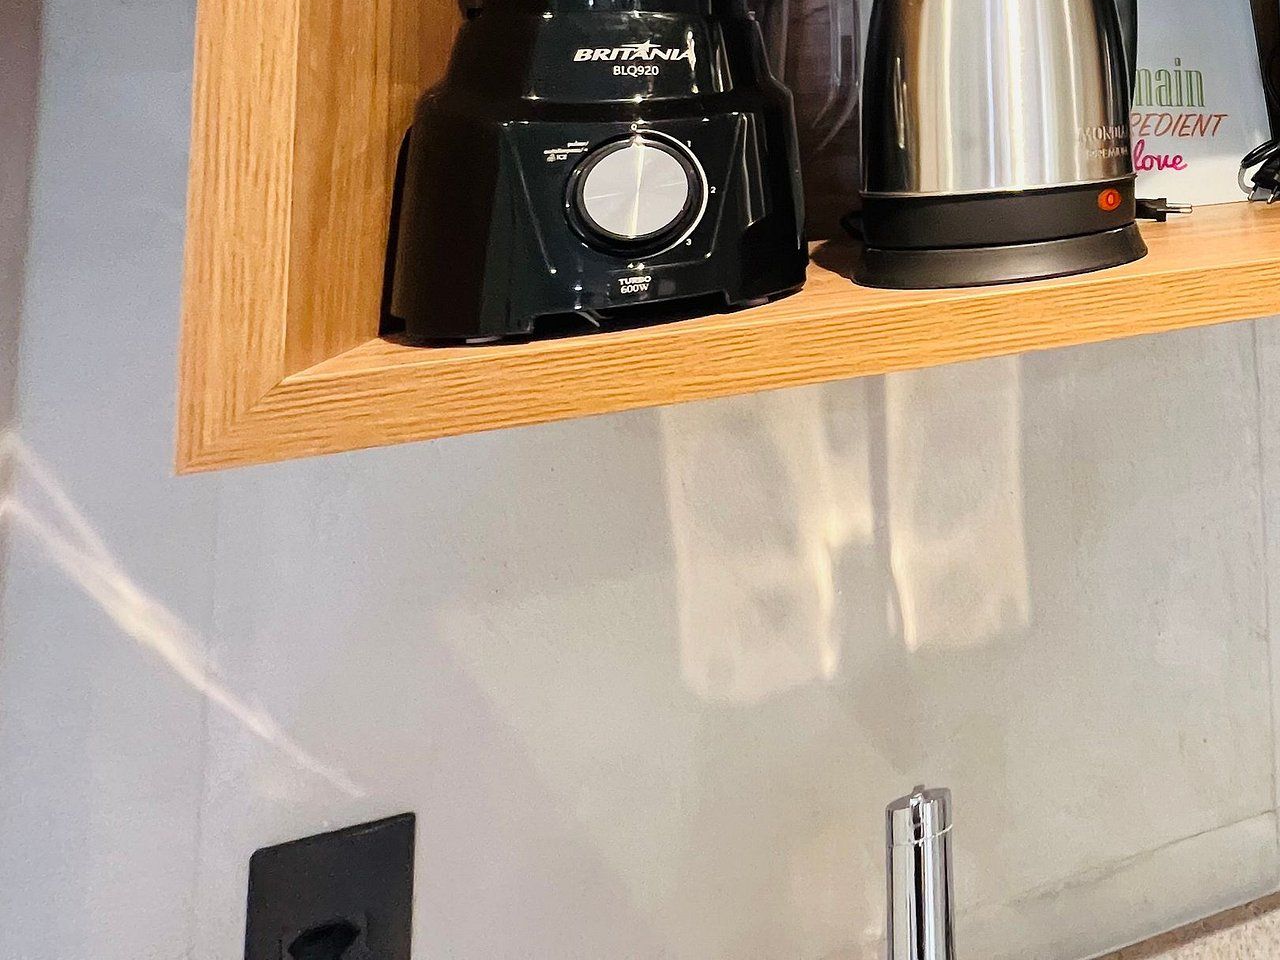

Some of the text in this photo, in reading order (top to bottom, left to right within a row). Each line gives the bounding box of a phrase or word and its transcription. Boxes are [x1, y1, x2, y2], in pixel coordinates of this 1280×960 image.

[612, 65, 660, 78] BLQ920
[1133, 139, 1188, 171] love
[710, 186, 716, 194] 2
[618, 275, 652, 286] TURBO
[620, 283, 650, 294] 600W
